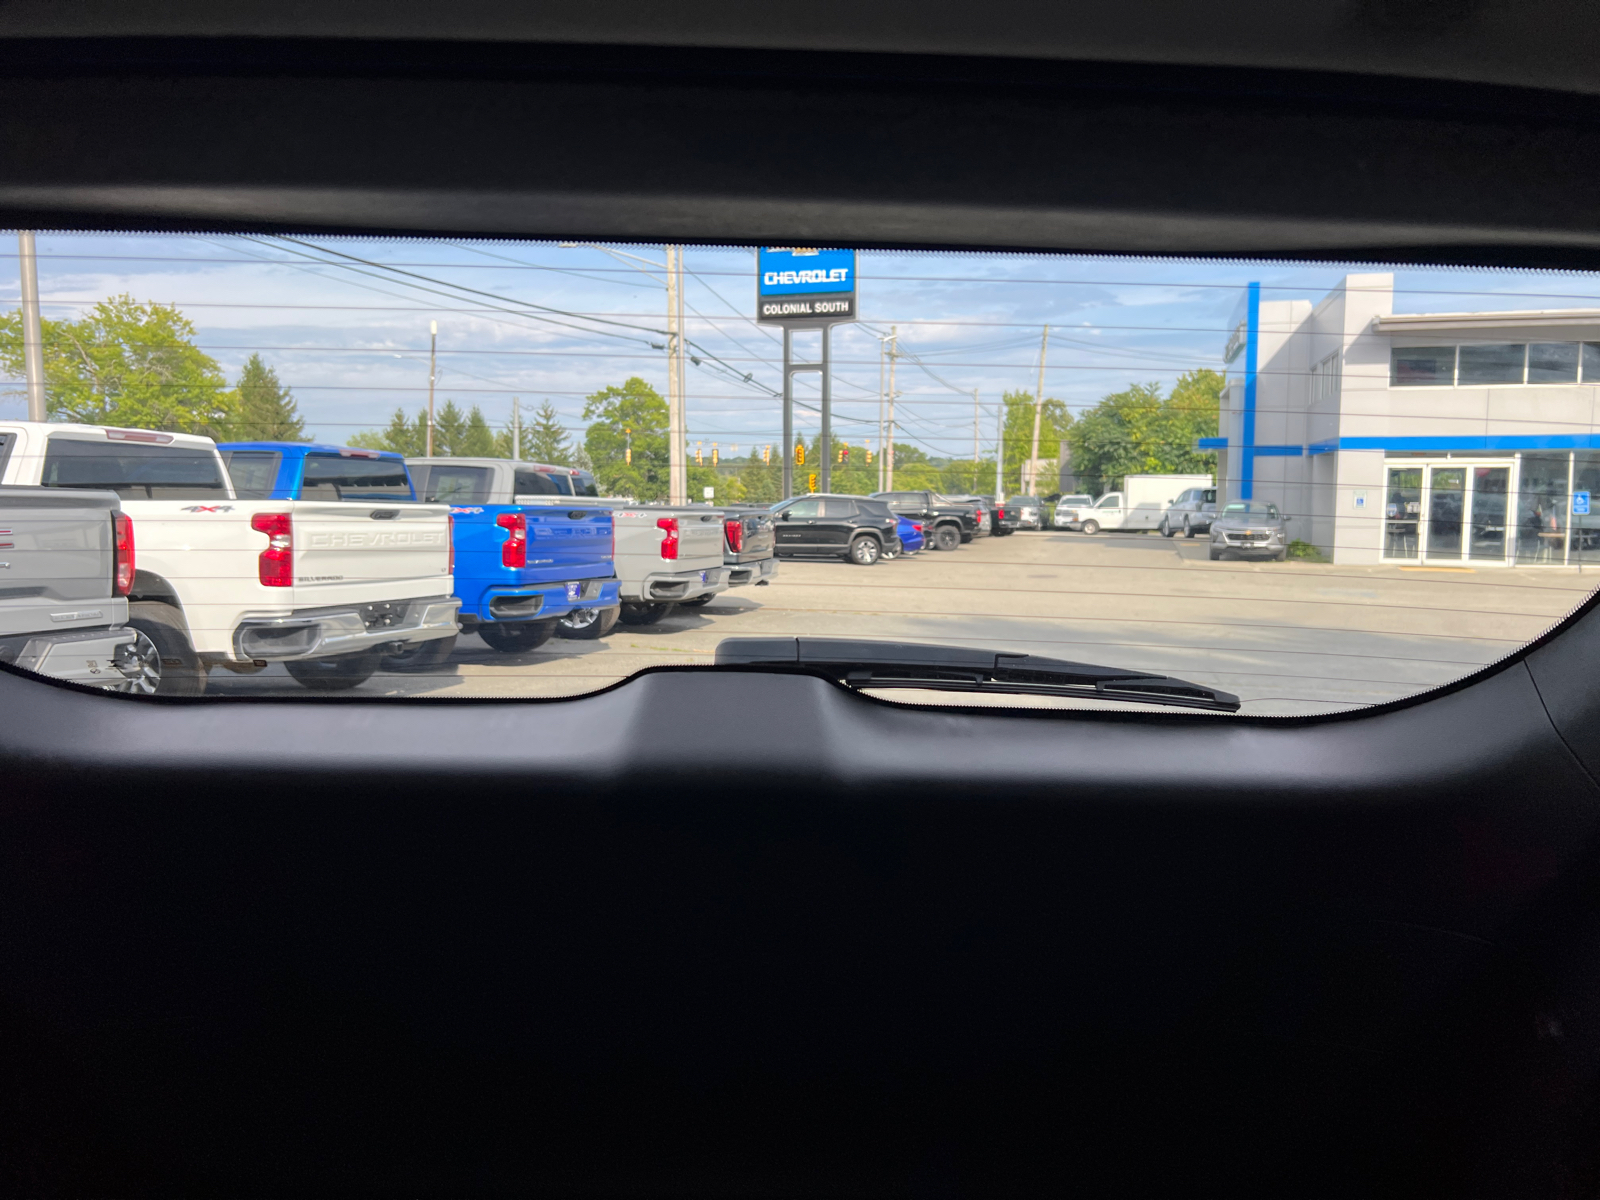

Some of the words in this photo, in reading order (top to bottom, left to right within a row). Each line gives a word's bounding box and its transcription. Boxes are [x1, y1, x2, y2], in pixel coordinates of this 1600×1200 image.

[764, 268, 848, 285] CHEVROLET
[763, 303, 812, 315] COLONIAL
[814, 301, 849, 313] SOUTH
[311, 531, 445, 547] CHEVROLET
